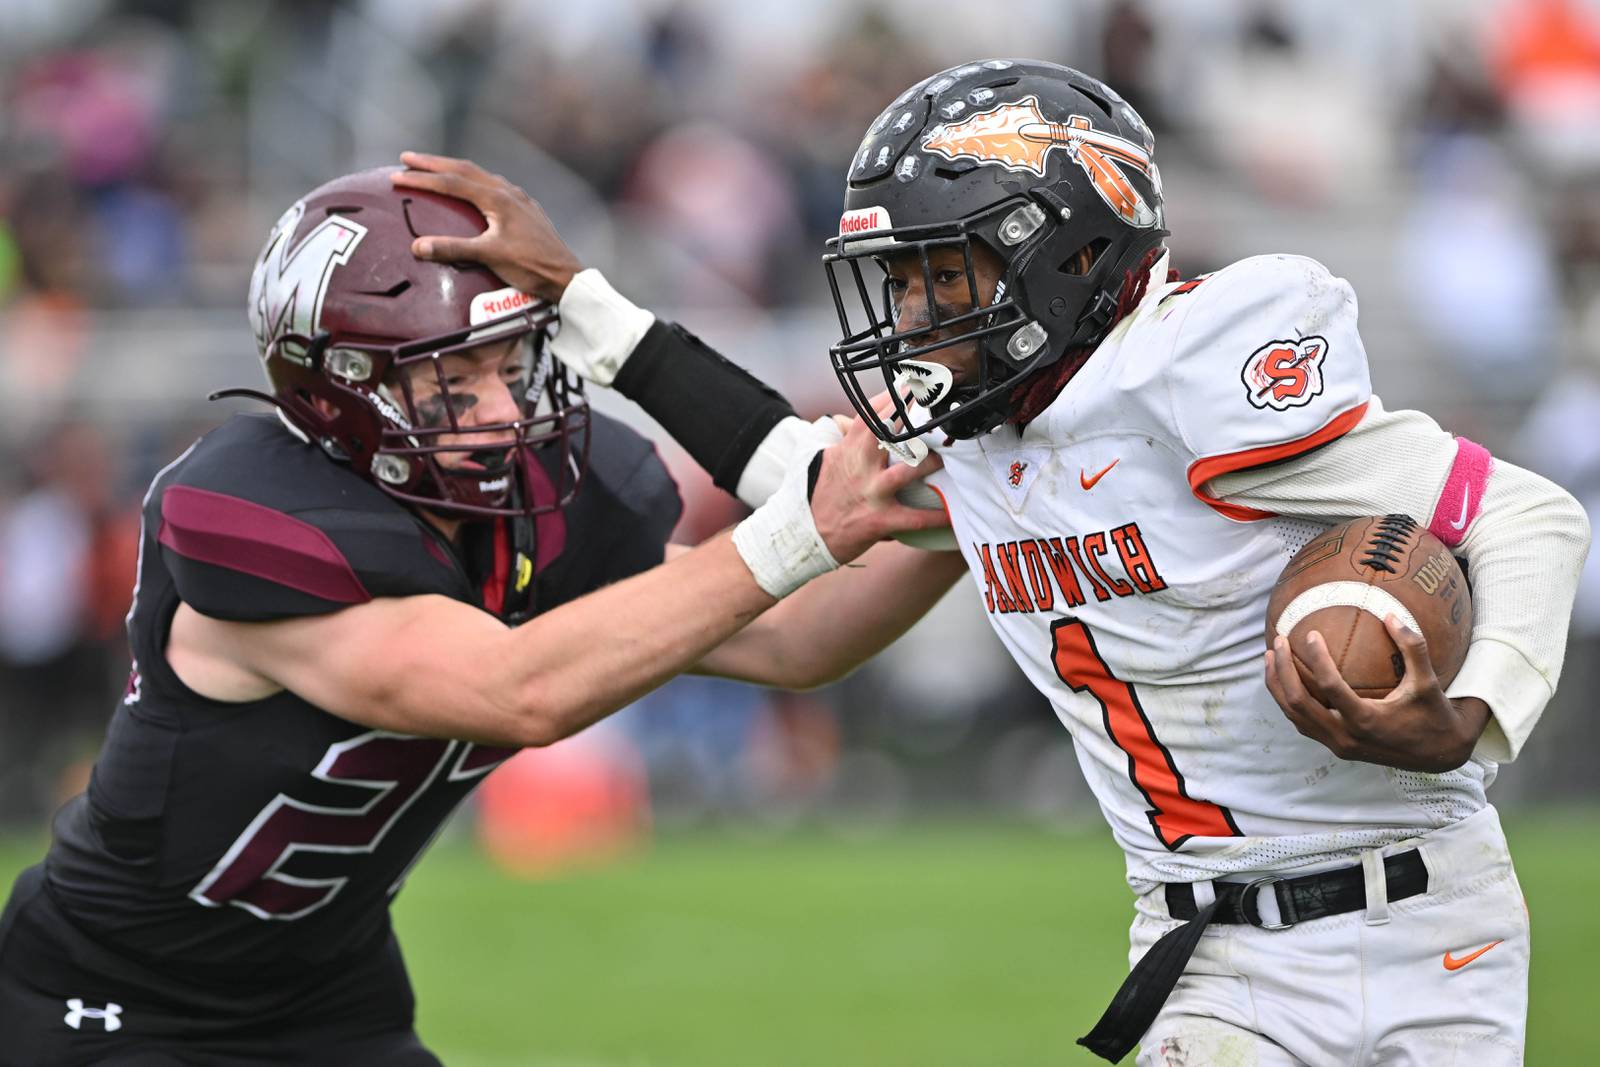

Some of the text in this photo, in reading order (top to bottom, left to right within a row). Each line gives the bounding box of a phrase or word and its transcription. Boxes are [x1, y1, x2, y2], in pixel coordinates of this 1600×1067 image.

[841, 212, 878, 234] Riddell
[483, 290, 538, 314] Ridde
[1264, 348, 1309, 402] S
[1050, 616, 1246, 853] 1
[188, 730, 525, 921] 2
